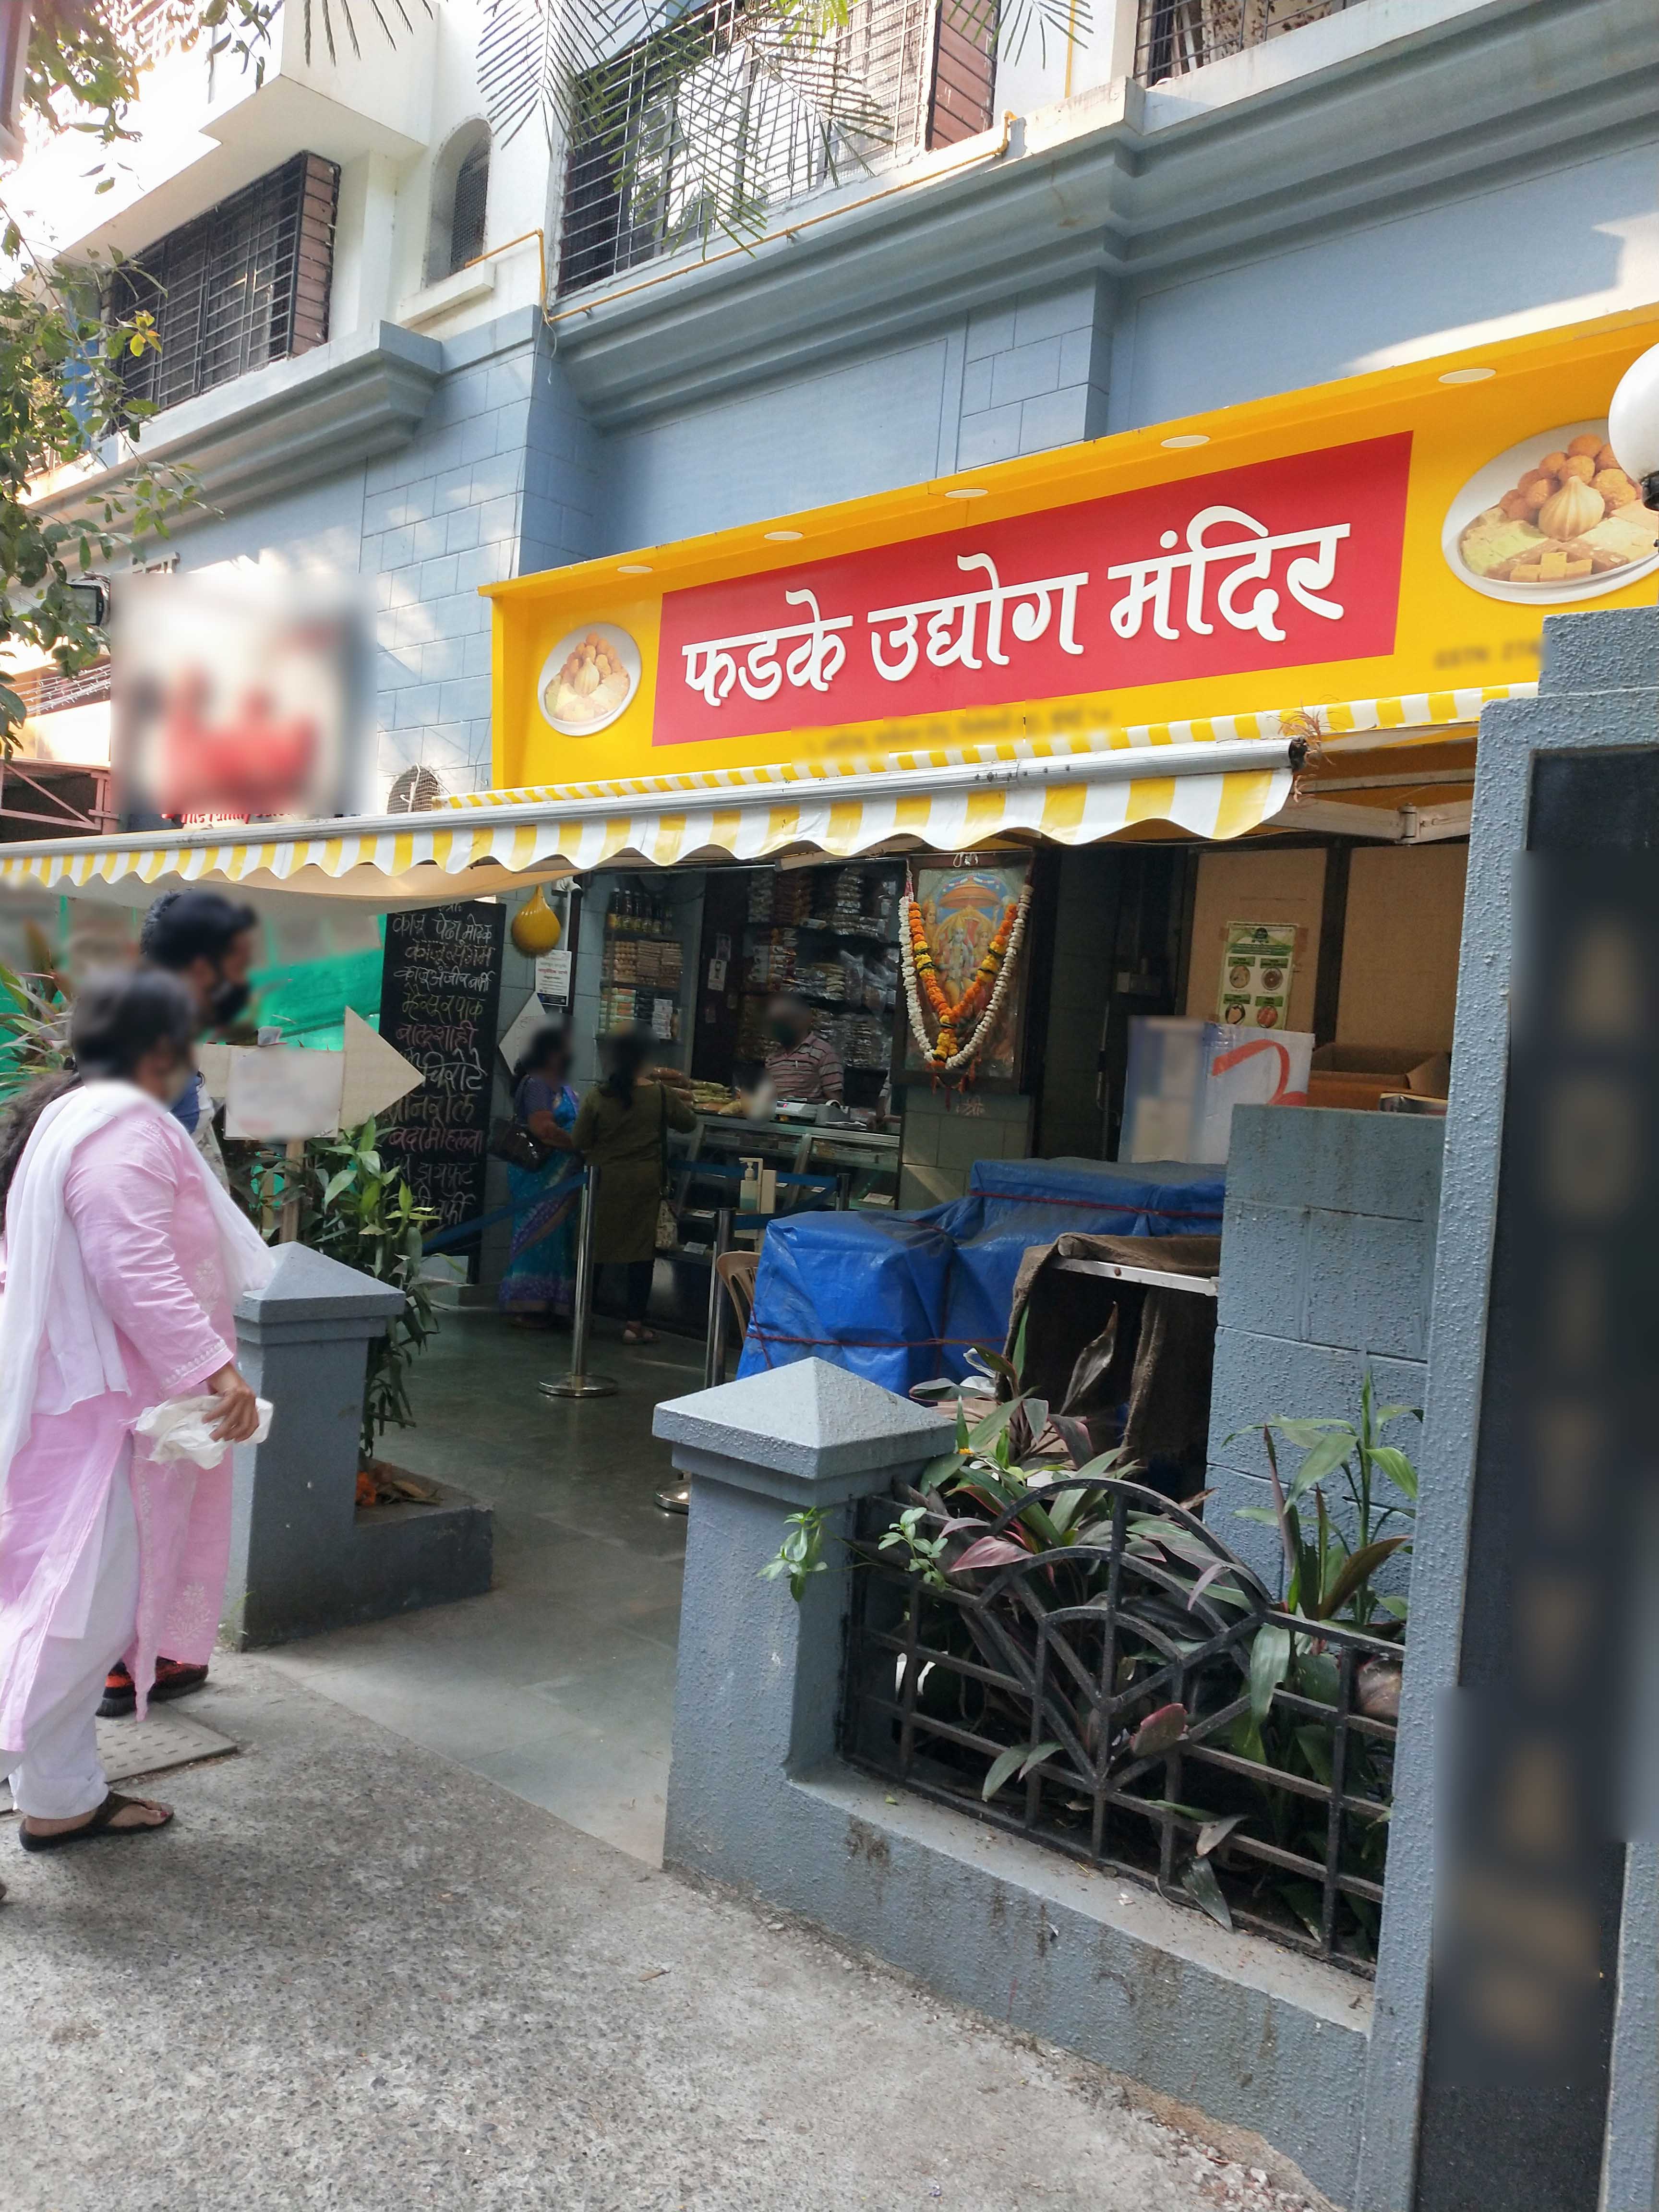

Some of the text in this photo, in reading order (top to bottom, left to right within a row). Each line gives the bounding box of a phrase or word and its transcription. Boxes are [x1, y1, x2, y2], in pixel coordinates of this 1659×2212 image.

[682, 505, 1350, 707] फडके उद्योग मंदिर
[392, 913, 426, 939] काजू
[462, 913, 493, 944] मोदक
[404, 938, 449, 967] काजू
[455, 995, 486, 1022] पाक
